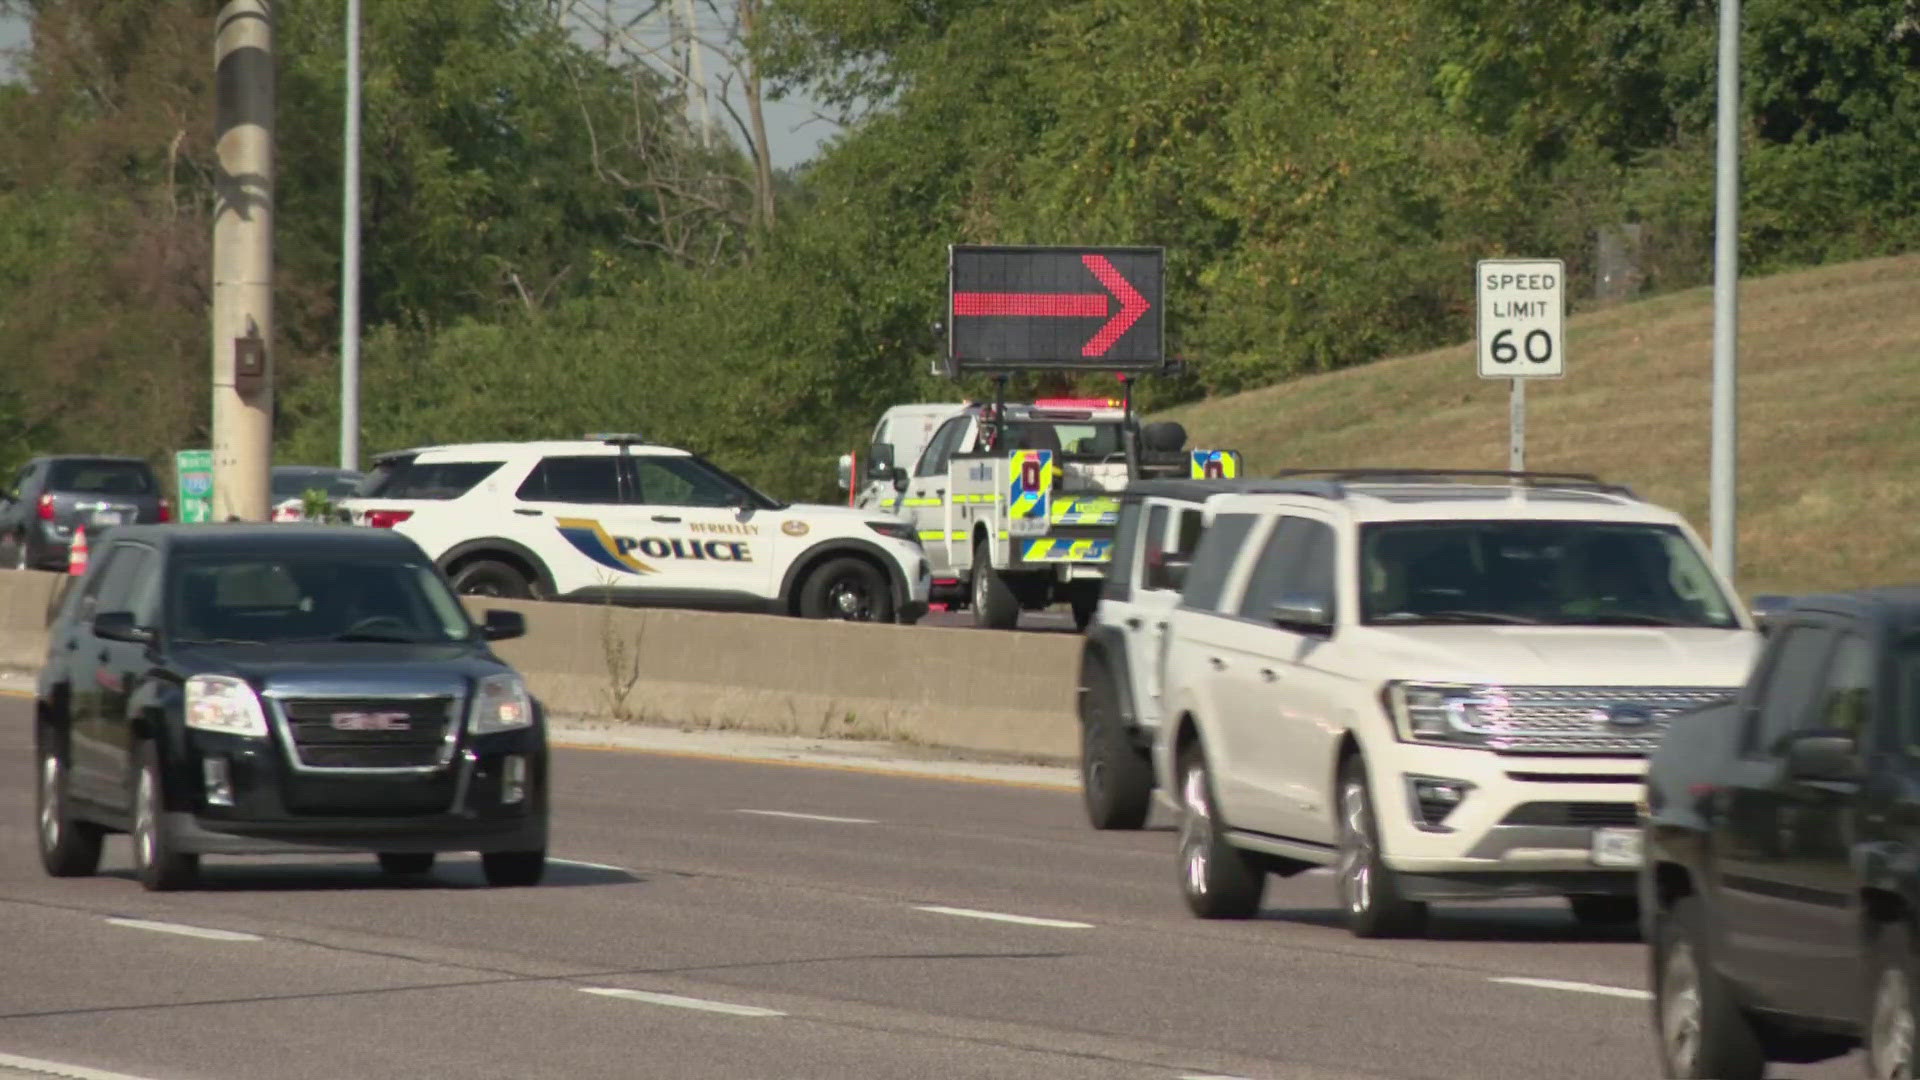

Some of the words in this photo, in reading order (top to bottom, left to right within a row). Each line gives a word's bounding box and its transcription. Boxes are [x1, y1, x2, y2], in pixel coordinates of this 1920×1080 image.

[1486, 274, 1555, 290] SPEED
[1493, 301, 1547, 317] LIMIT
[1490, 329, 1553, 364] 60
[690, 522, 758, 536] BERKELEY
[614, 536, 753, 562] POLICE
